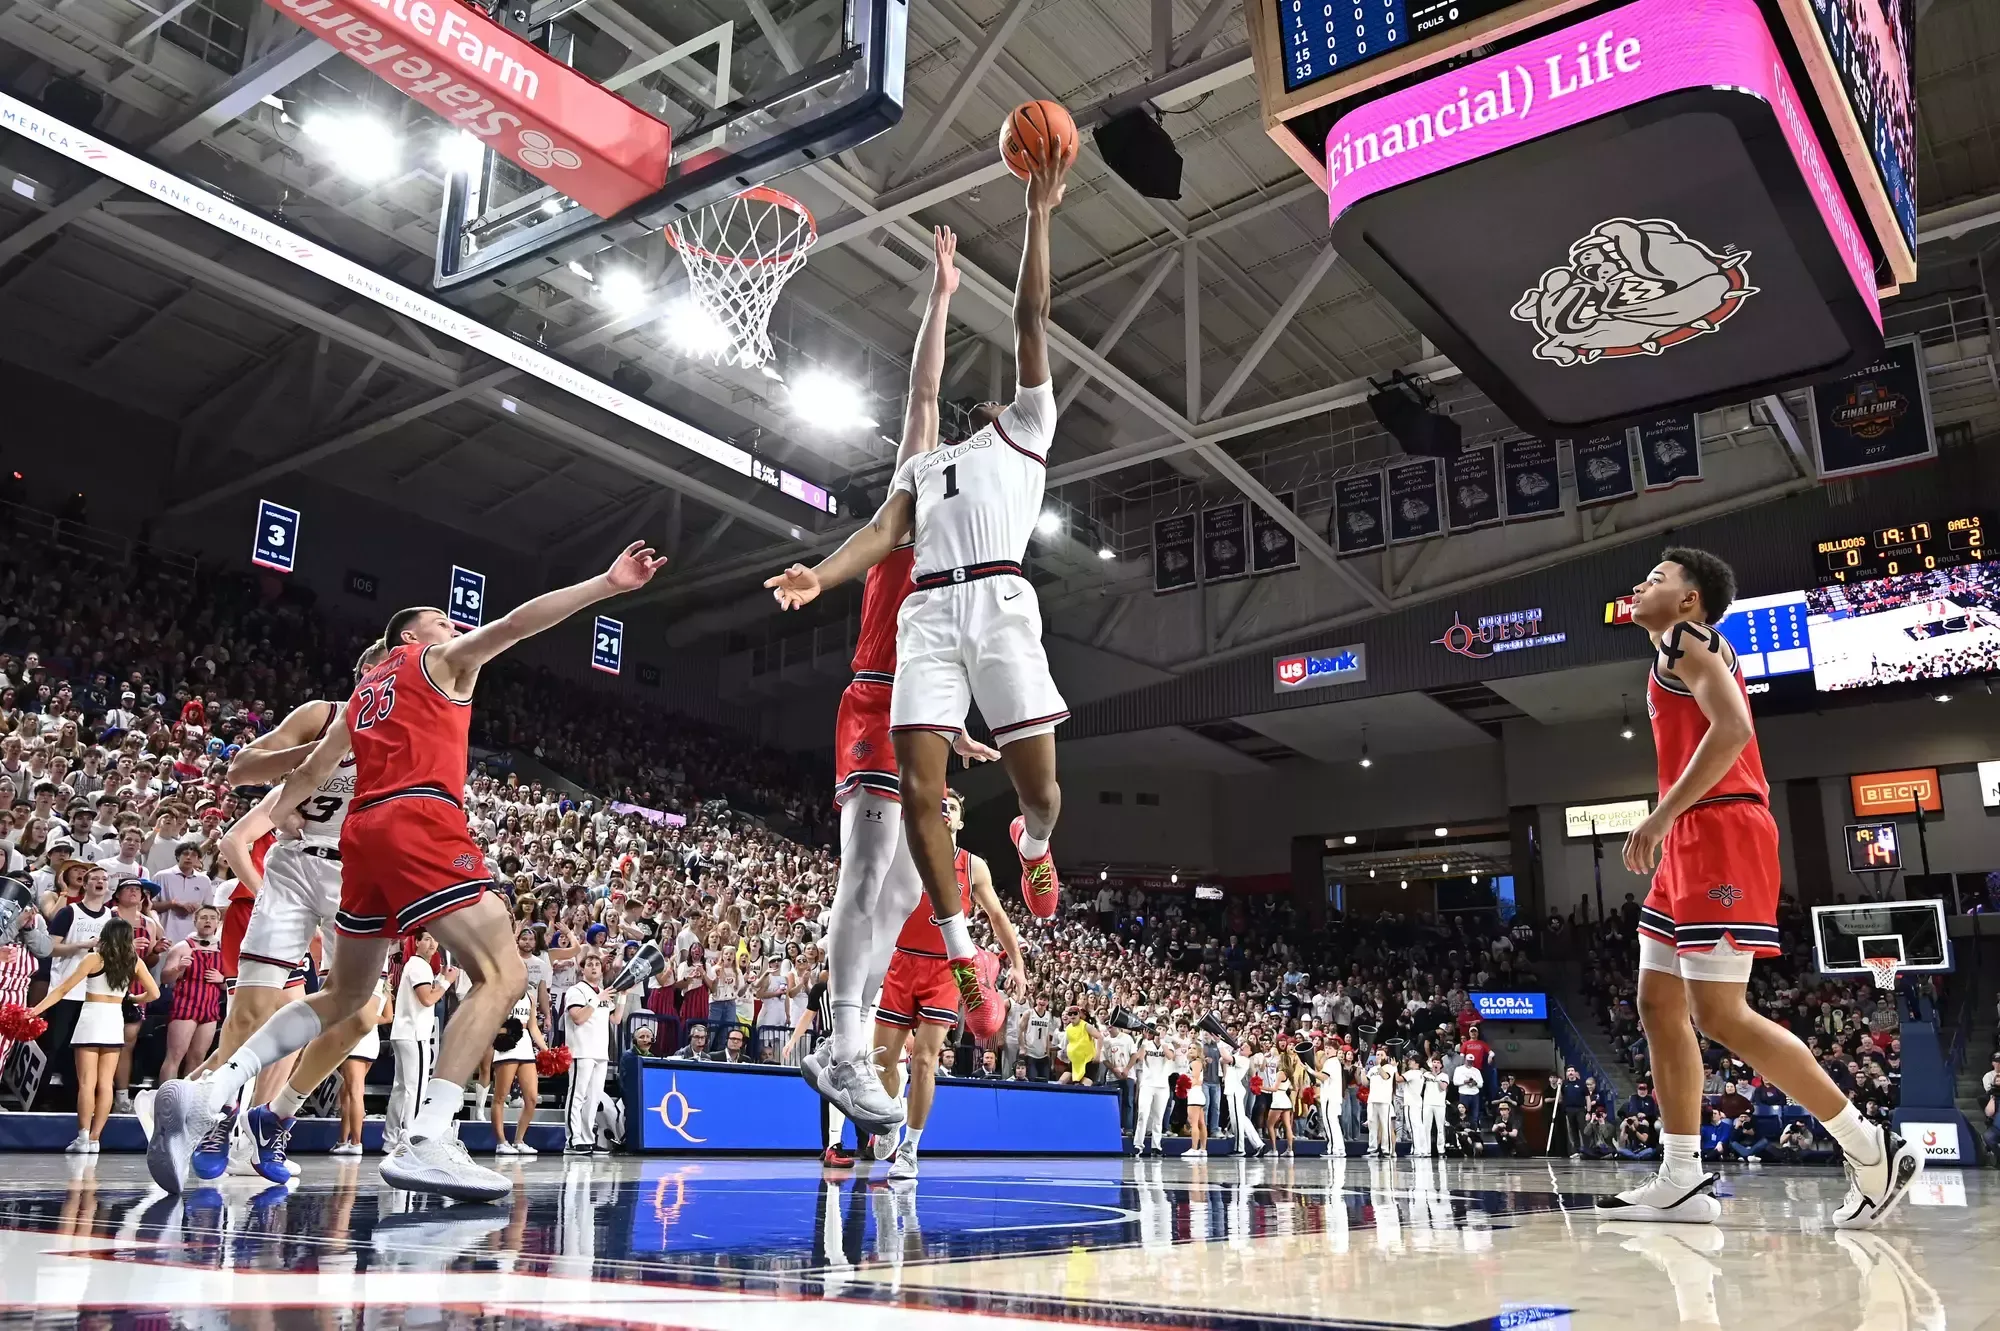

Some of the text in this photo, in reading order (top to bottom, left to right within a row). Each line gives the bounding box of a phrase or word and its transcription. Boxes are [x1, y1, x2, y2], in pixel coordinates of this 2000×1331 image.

[1295, 4, 1332, 28] 1 0
[1418, 7, 1459, 31] FOULS 0
[1294, 31, 1308, 45] 11
[1326, 21, 1334, 34] 0
[1354, 8, 1363, 20] 0
[1295, 12, 1394, 63] 15 0 0 0
[1296, 29, 1396, 79] 33 0 0 0
[1330, 29, 1642, 190] Financial) Life
[150, 179, 283, 247] BANK OF AMERICA
[348, 273, 381, 296] BANK
[404, 301, 457, 331] AMERICA
[1841, 400, 1897, 420] FINAL FOUR
[1865, 445, 1886, 455] 2017
[942, 464, 960, 499] 1
[1947, 517, 1980, 531] GAELS
[267, 524, 286, 547] 3
[1882, 523, 1929, 545] 19:17
[1969, 529, 1980, 546] 2
[1818, 537, 1866, 553] BULLDOGS
[1887, 544, 1922, 557] PERIOD 1
[1846, 550, 1859, 566] 0
[1925, 555, 1961, 569] 0 FOULS
[1971, 549, 1982, 560] 4
[953, 568, 966, 582] G
[1835, 571, 1845, 582] 4
[1856, 561, 1898, 577] FOULS 0
[353, 577, 373, 592] 106
[453, 586, 480, 610] 13
[1478, 608, 1542, 627] NORTHERN
[596, 633, 619, 655] 21
[1307, 651, 1357, 675] bank
[354, 674, 397, 732] 23
[1867, 786, 1926, 801] BECU
[1608, 809, 1646, 820] URGENT
[1609, 818, 1634, 828] CARE
[317, 847, 327, 857] G
[1480, 998, 1533, 1008] GLOBAL
